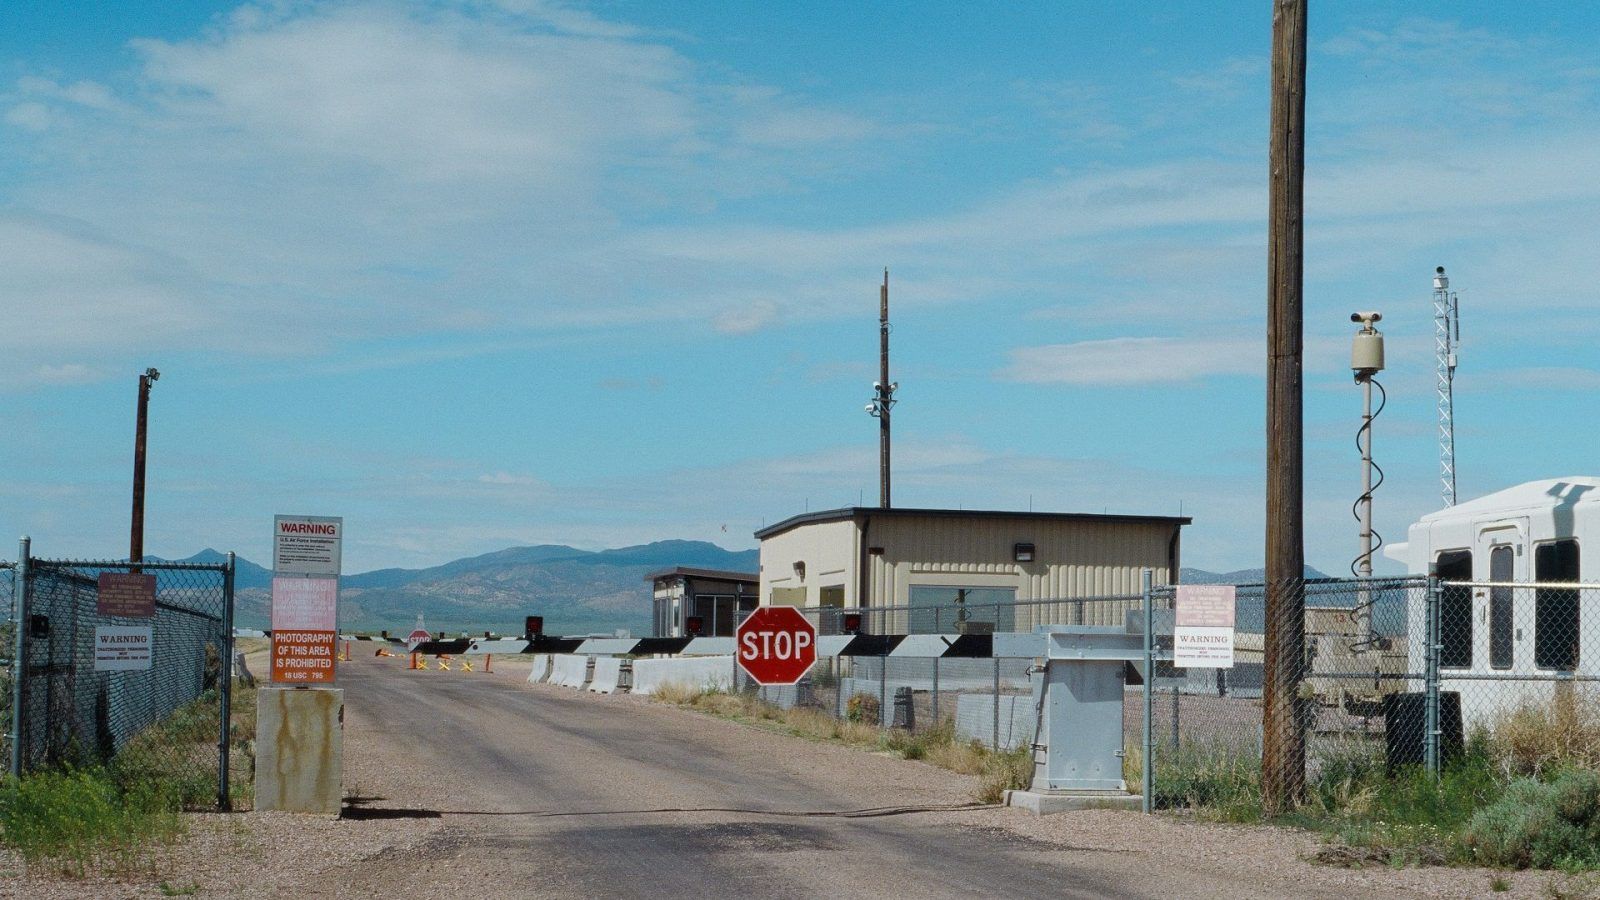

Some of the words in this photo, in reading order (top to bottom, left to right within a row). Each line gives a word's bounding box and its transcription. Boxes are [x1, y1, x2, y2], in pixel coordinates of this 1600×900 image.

[281, 523, 336, 535] WARNING
[100, 635, 147, 643] WARNING
[275, 633, 334, 643] PHOTOGRAPHY
[1180, 635, 1227, 643] WARNING
[278, 645, 289, 655] OF
[290, 645, 308, 655] THIS
[308, 646, 331, 655] AREA
[742, 631, 811, 660] STOP
[276, 658, 284, 668] IS
[285, 658, 332, 668] PROHIBITED
